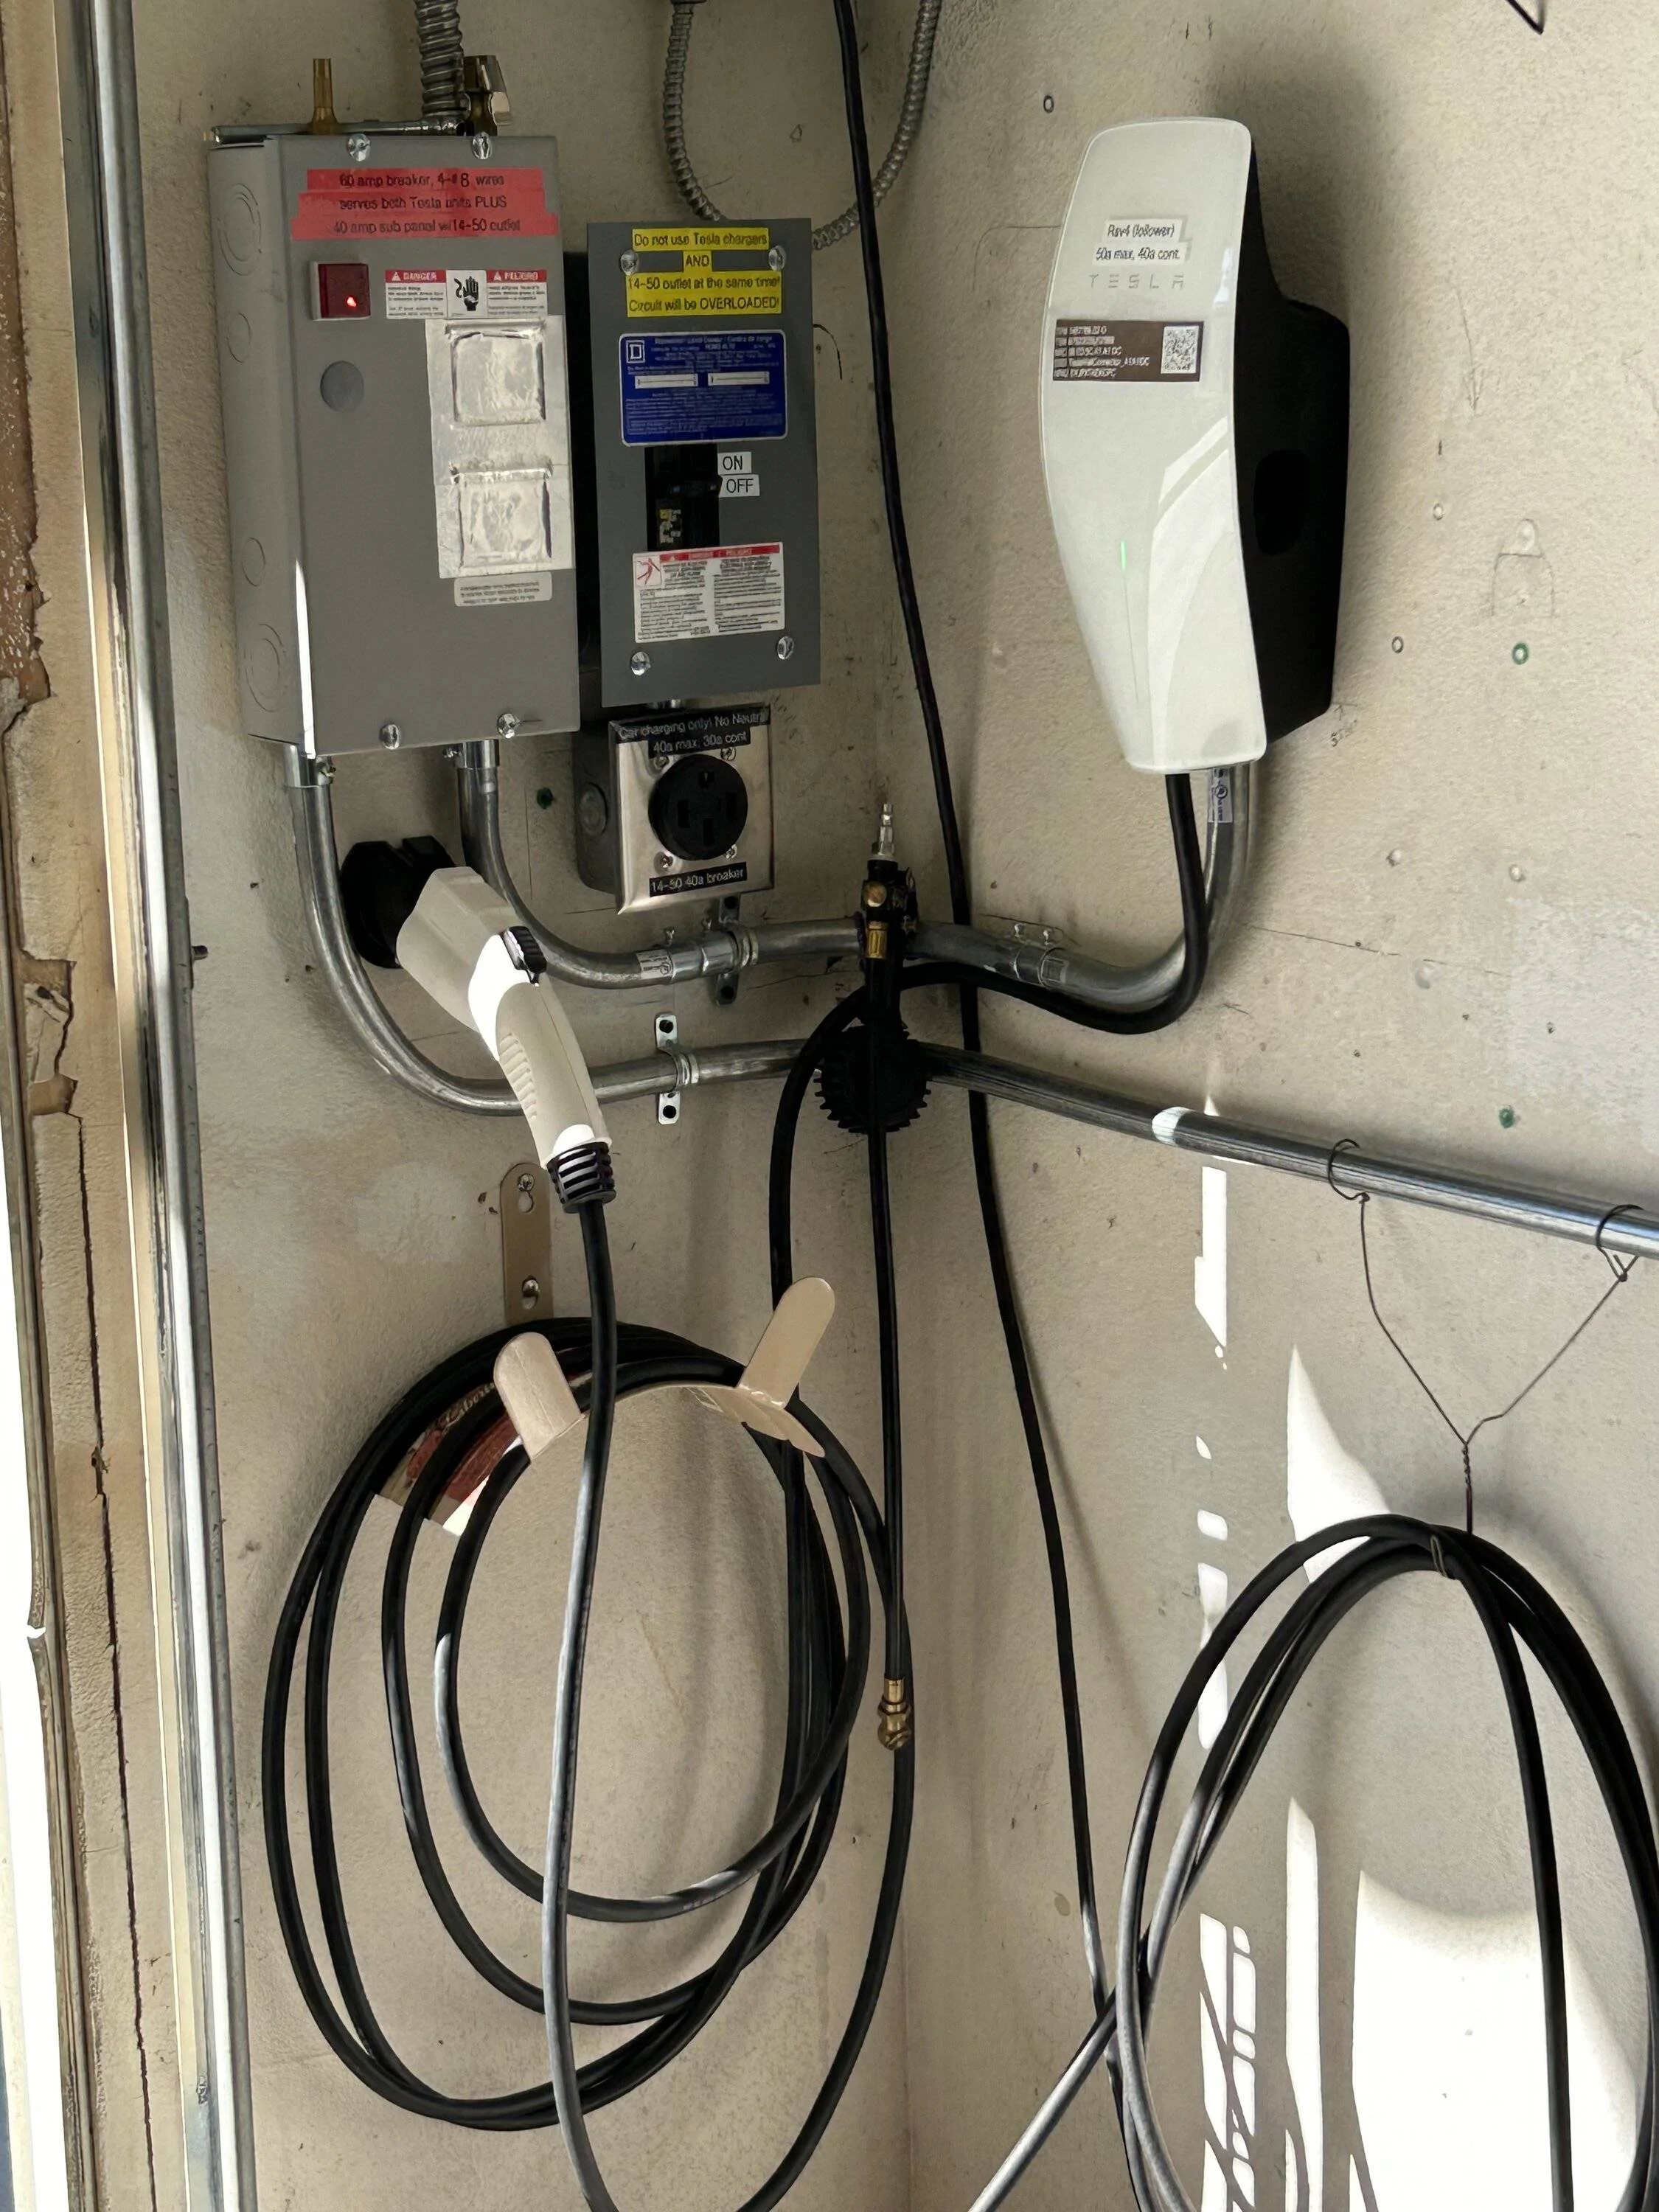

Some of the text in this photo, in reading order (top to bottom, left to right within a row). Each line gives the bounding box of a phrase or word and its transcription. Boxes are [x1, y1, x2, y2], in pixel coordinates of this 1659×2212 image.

[357, 176, 383, 187] amp
[476, 175, 504, 186] wires
[340, 195, 507, 210] serves both Tesla units PLUS
[334, 220, 347, 234] 40
[351, 223, 377, 234] amp
[380, 220, 401, 233] sub
[405, 219, 435, 233] panel
[490, 219, 521, 232] outlet
[634, 232, 767, 246] Do not use Tesla chargers
[686, 254, 710, 267] AND
[628, 276, 661, 290] 14-50
[663, 276, 692, 289] outlet
[694, 276, 704, 289] at
[707, 276, 723, 288] the
[725, 277, 753, 288] same
[1088, 274, 1185, 290] TESLA
[629, 299, 662, 312] Circuit
[665, 298, 681, 310] will
[684, 298, 697, 310] be
[723, 455, 743, 471] ON
[726, 478, 754, 493] OFF
[714, 714, 730, 728] No
[654, 740, 673, 753] 40a
[703, 734, 723, 747] 30a
[652, 868, 744, 893] 14-50 40a breaker
